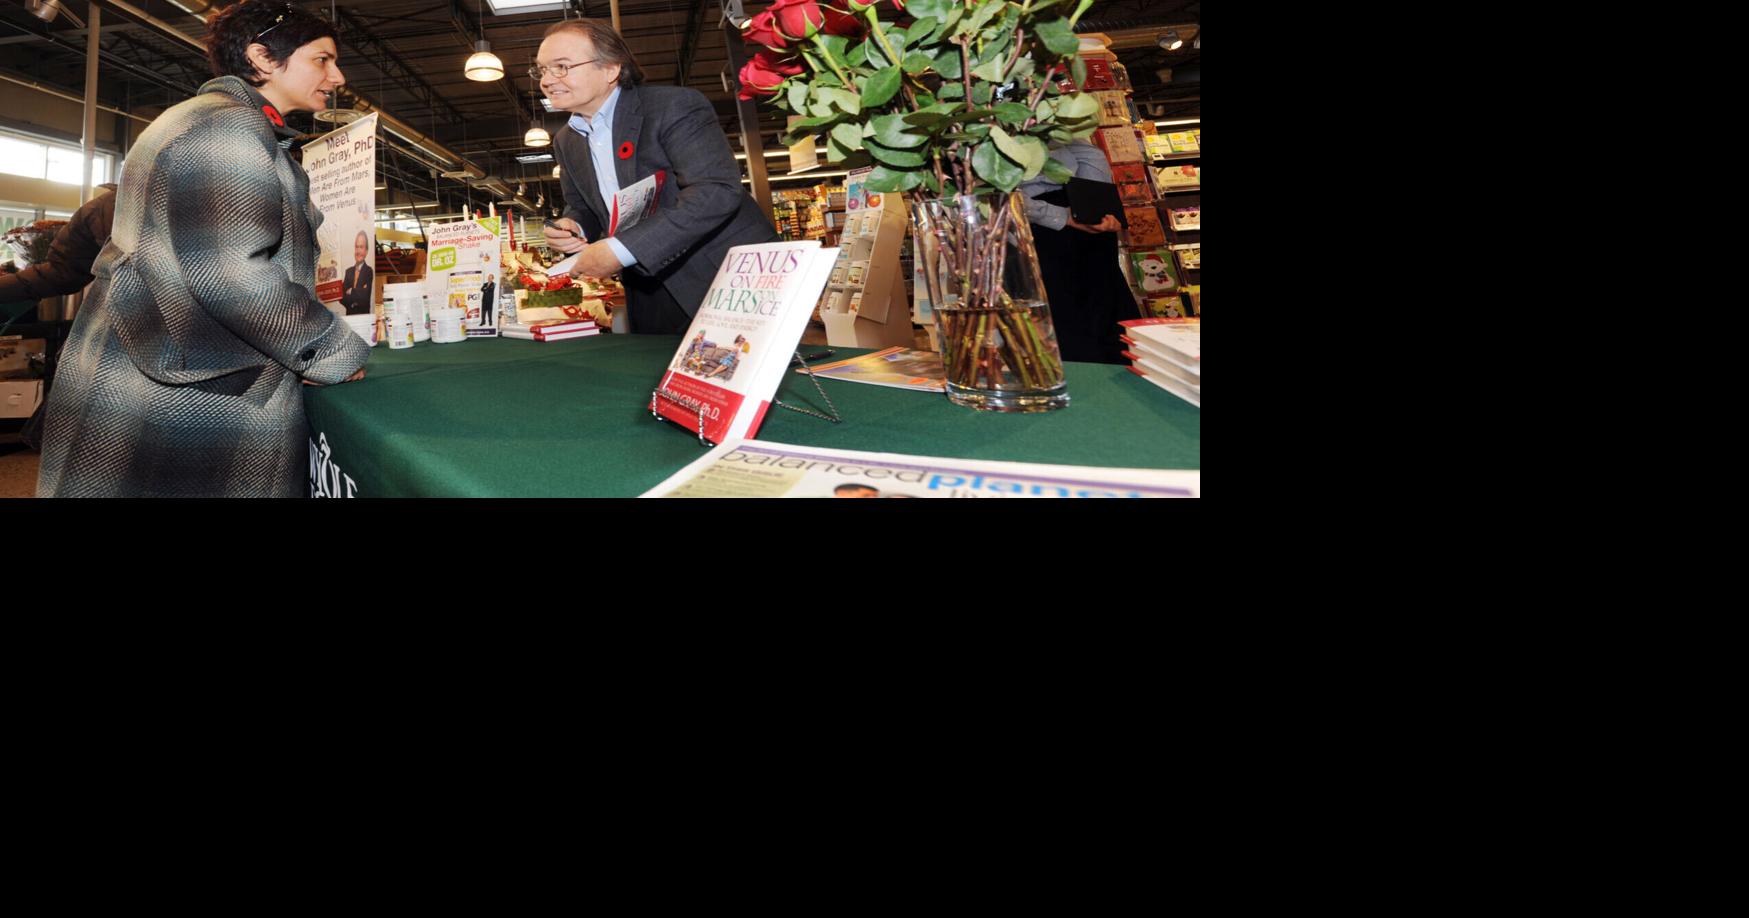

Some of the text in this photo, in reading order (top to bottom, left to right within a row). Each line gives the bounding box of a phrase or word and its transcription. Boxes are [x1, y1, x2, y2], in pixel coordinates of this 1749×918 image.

[326, 131, 350, 151] Meet
[328, 148, 351, 164] Gray,
[354, 135, 374, 154] PhD
[341, 159, 363, 174] author
[321, 182, 333, 192] Are
[334, 176, 350, 188] From
[320, 185, 356, 202] Women Are
[320, 198, 356, 212] From Venus
[431, 227, 451, 235] John
[453, 222, 477, 232] Gray's
[724, 249, 804, 274] VENUS
[730, 274, 786, 289] ON FIRE
[701, 288, 763, 314] MARS
[755, 300, 782, 316] ICE
